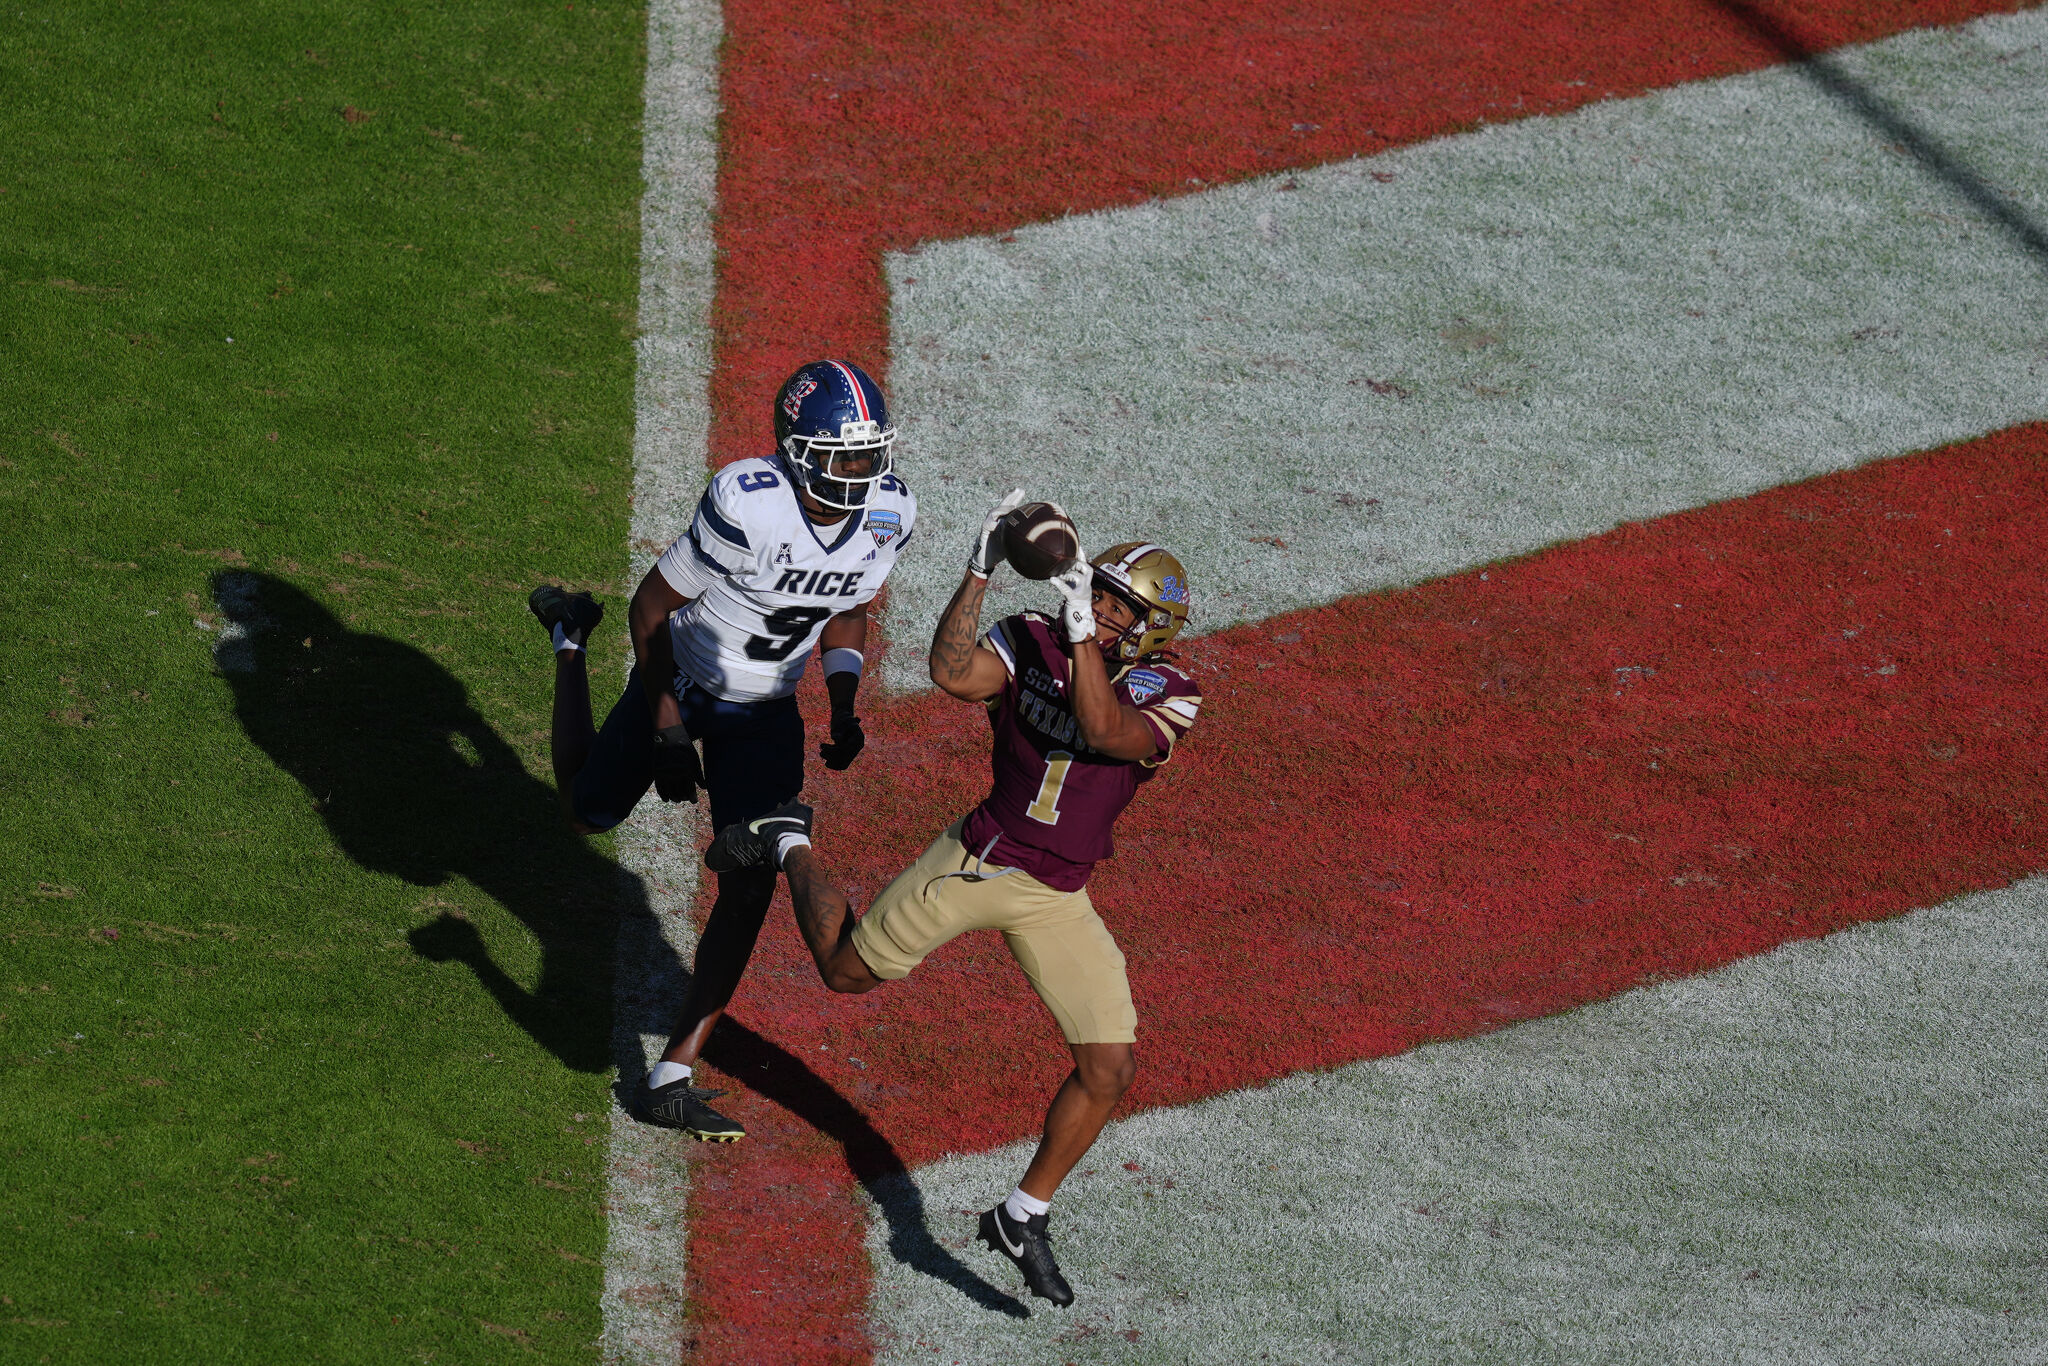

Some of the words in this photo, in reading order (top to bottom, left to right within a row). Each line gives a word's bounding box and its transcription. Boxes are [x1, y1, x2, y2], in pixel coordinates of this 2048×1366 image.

[737, 471, 780, 493] 9
[773, 568, 865, 597] RICE
[1105, 563, 1128, 580] BOBCATS
[743, 606, 832, 661] 9
[1019, 689, 1078, 744] TEXAS
[1026, 750, 1074, 825] 1
